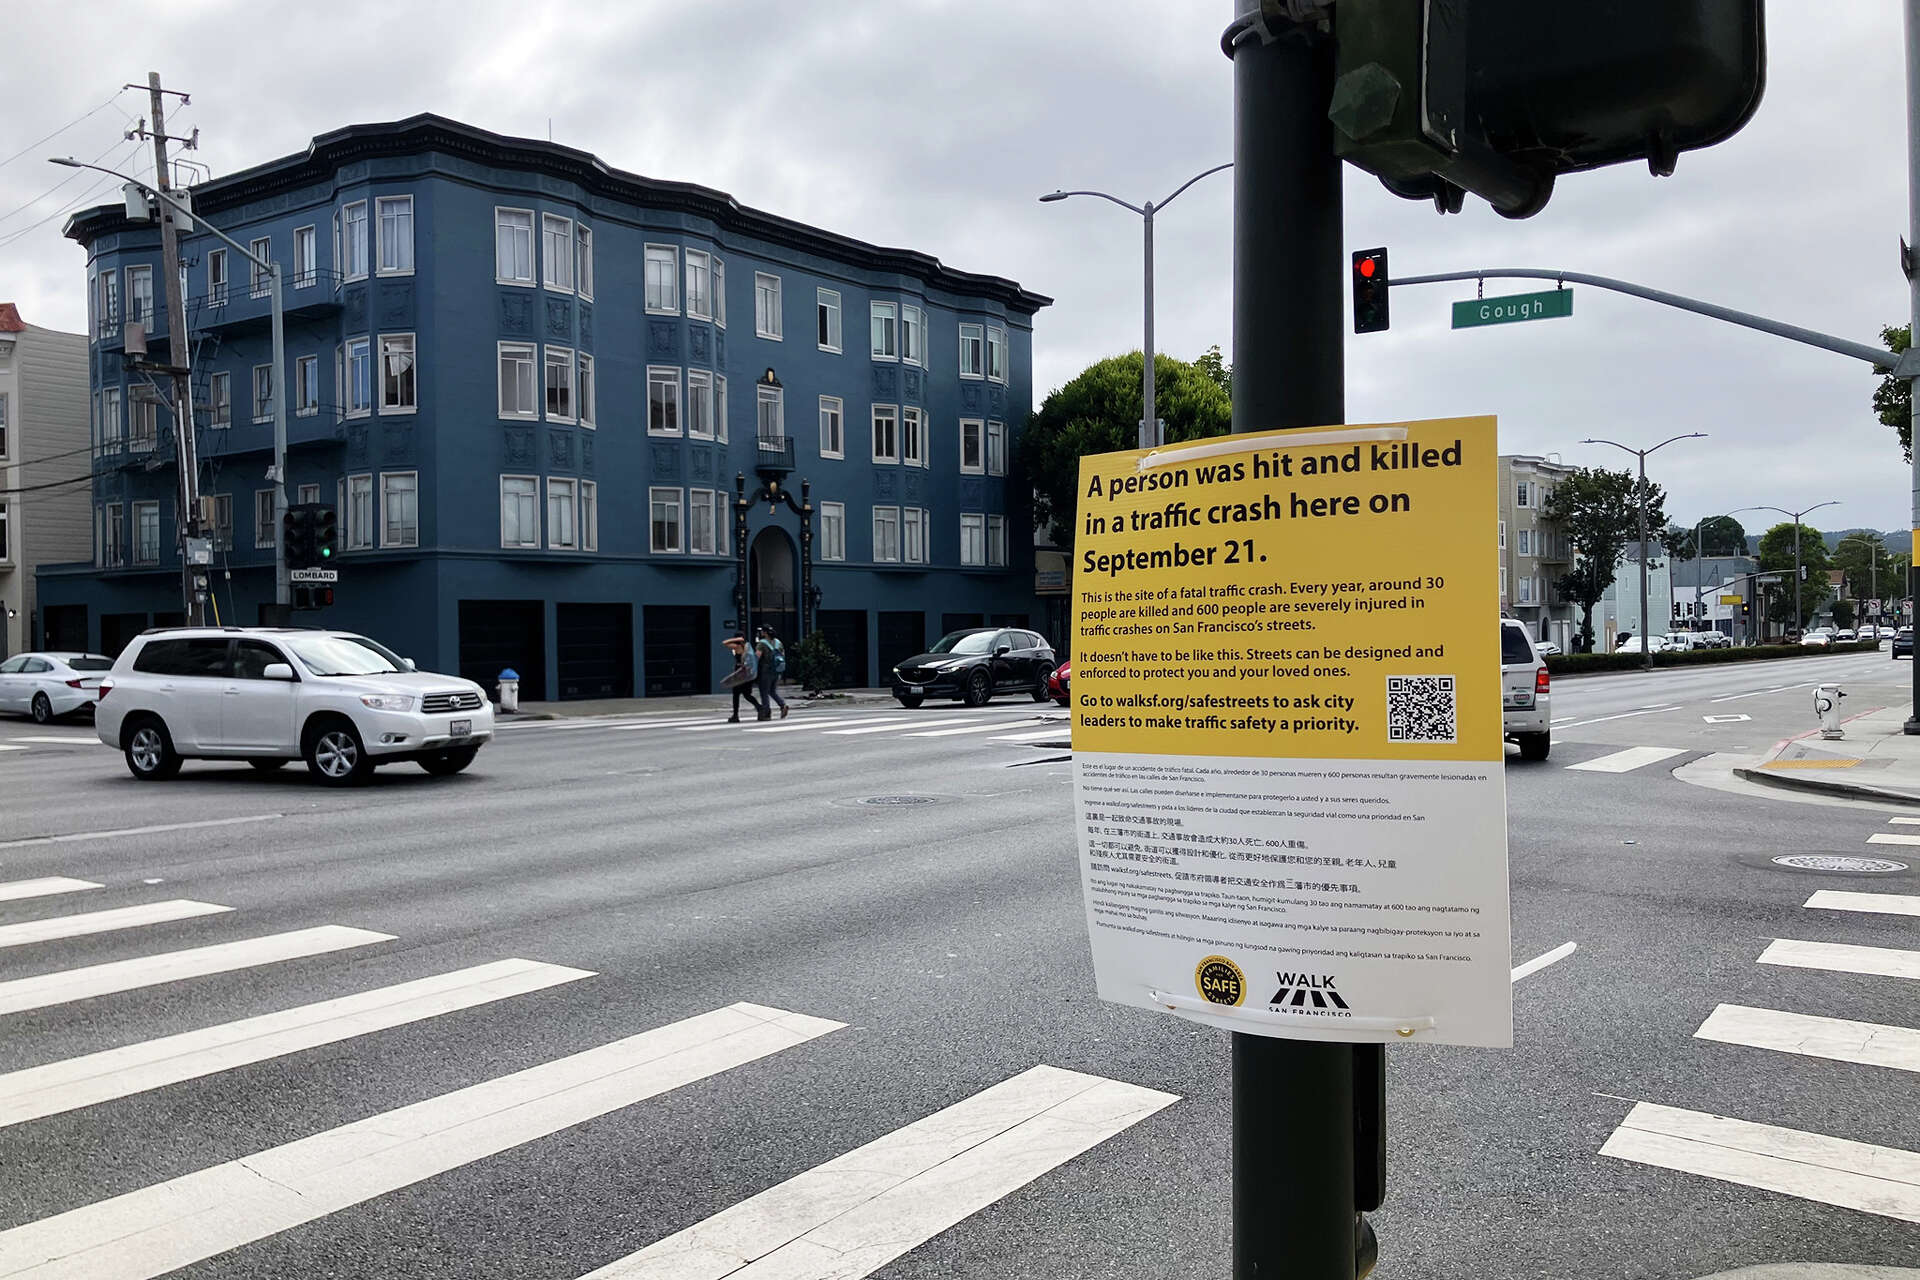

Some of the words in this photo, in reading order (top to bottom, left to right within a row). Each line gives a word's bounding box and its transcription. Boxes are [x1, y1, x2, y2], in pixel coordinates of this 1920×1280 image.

[1480, 300, 1542, 319] Gough
[1087, 475, 1103, 498] A
[1109, 469, 1189, 502] person
[1195, 463, 1246, 485] was
[1253, 452, 1293, 479] hit
[1301, 446, 1360, 475] and
[1371, 440, 1462, 471] killed
[1085, 513, 1106, 535] in
[1111, 516, 1124, 533] a
[1130, 502, 1201, 531] traffic
[1207, 494, 1281, 524] crash
[1290, 492, 1360, 518] here
[1369, 493, 1410, 514] on
[1083, 542, 1217, 578] September
[1224, 539, 1267, 564] 21.
[1081, 592, 1102, 603] This
[1104, 592, 1113, 602] is
[1115, 590, 1133, 602] the
[1135, 589, 1154, 601] site
[1157, 588, 1169, 600] of
[1170, 590, 1177, 599] a
[1180, 586, 1206, 599] fatal
[1209, 584, 1245, 598] traffic
[1248, 583, 1287, 596] crash.
[1290, 582, 1328, 596] Every
[1331, 583, 1365, 596] year,
[1369, 577, 1422, 591] around
[1426, 577, 1444, 589] 30
[1081, 607, 1117, 623] people
[1119, 609, 1136, 619] are
[1138, 605, 1169, 617] killed
[1171, 604, 1194, 616] and
[1196, 604, 1219, 616] 600
[1222, 601, 1266, 617] people
[1269, 603, 1291, 613] are
[1294, 598, 1351, 614] severely
[1355, 596, 1407, 613] injured
[1411, 596, 1425, 609] in
[1080, 624, 1111, 636] traffic
[1112, 623, 1153, 635] crashes
[1155, 625, 1170, 634] on
[1173, 622, 1194, 634] San
[1267, 619, 1316, 631] streets.
[1080, 652, 1088, 663] It
[1131, 651, 1158, 662] have
[1160, 651, 1173, 662] to
[1175, 649, 1190, 661] be
[1193, 649, 1214, 661] like
[1217, 649, 1244, 661] this.
[1246, 648, 1292, 660] Streets
[1296, 650, 1320, 660] can
[1323, 647, 1341, 659] be
[1344, 645, 1411, 662] designed
[1415, 644, 1444, 658] and
[1080, 667, 1126, 679] enforced
[1129, 668, 1141, 678] to
[1143, 667, 1185, 681] protect
[1187, 669, 1210, 681] you
[1213, 665, 1236, 678] and
[1239, 668, 1269, 681] your
[1272, 664, 1310, 677] loved
[1313, 667, 1351, 677] ones.
[1080, 694, 1098, 707] Go
[1100, 696, 1113, 707] to
[1116, 694, 1269, 711] walksf.org/safestreets
[1273, 696, 1289, 708] to
[1293, 698, 1321, 708] ask
[1324, 696, 1355, 712] city
[1080, 714, 1126, 727] leaders
[1128, 716, 1142, 728] to
[1145, 715, 1182, 728] make
[1185, 715, 1227, 729] traffic
[1230, 716, 1276, 733] safety
[1280, 720, 1289, 730] a
[1293, 716, 1359, 734] priority.
[1269, 771, 1297, 779] personas
[1341, 773, 1371, 781] personas
[1399, 774, 1440, 782] gravemente
[1205, 791, 1248, 801] implementarse
[1262, 794, 1296, 803] protegerlo
[1359, 797, 1390, 806] queridos.
[1251, 809, 1286, 817] establezcan
[1293, 811, 1325, 820] seguridad
[1371, 814, 1402, 822] prioridad
[1330, 902, 1343, 910] ang
[1343, 902, 1383, 912] namamatay
[1417, 906, 1431, 914] ang
[1432, 906, 1469, 916] nagtatamo
[1470, 908, 1480, 916] ng
[1277, 945, 1301, 956] gawing
[1301, 947, 1335, 958] priyoridad
[1335, 951, 1348, 959] ang
[1349, 950, 1383, 960] kaligtasan
[1392, 952, 1416, 962] trapiko
[1425, 953, 1438, 961] San
[1439, 954, 1472, 962] Francisco.
[1204, 977, 1238, 994] SAFE
[1277, 972, 1336, 988] WALK
[1269, 1006, 1287, 1014] SAN
[1293, 1009, 1352, 1017] FRANCISCO
